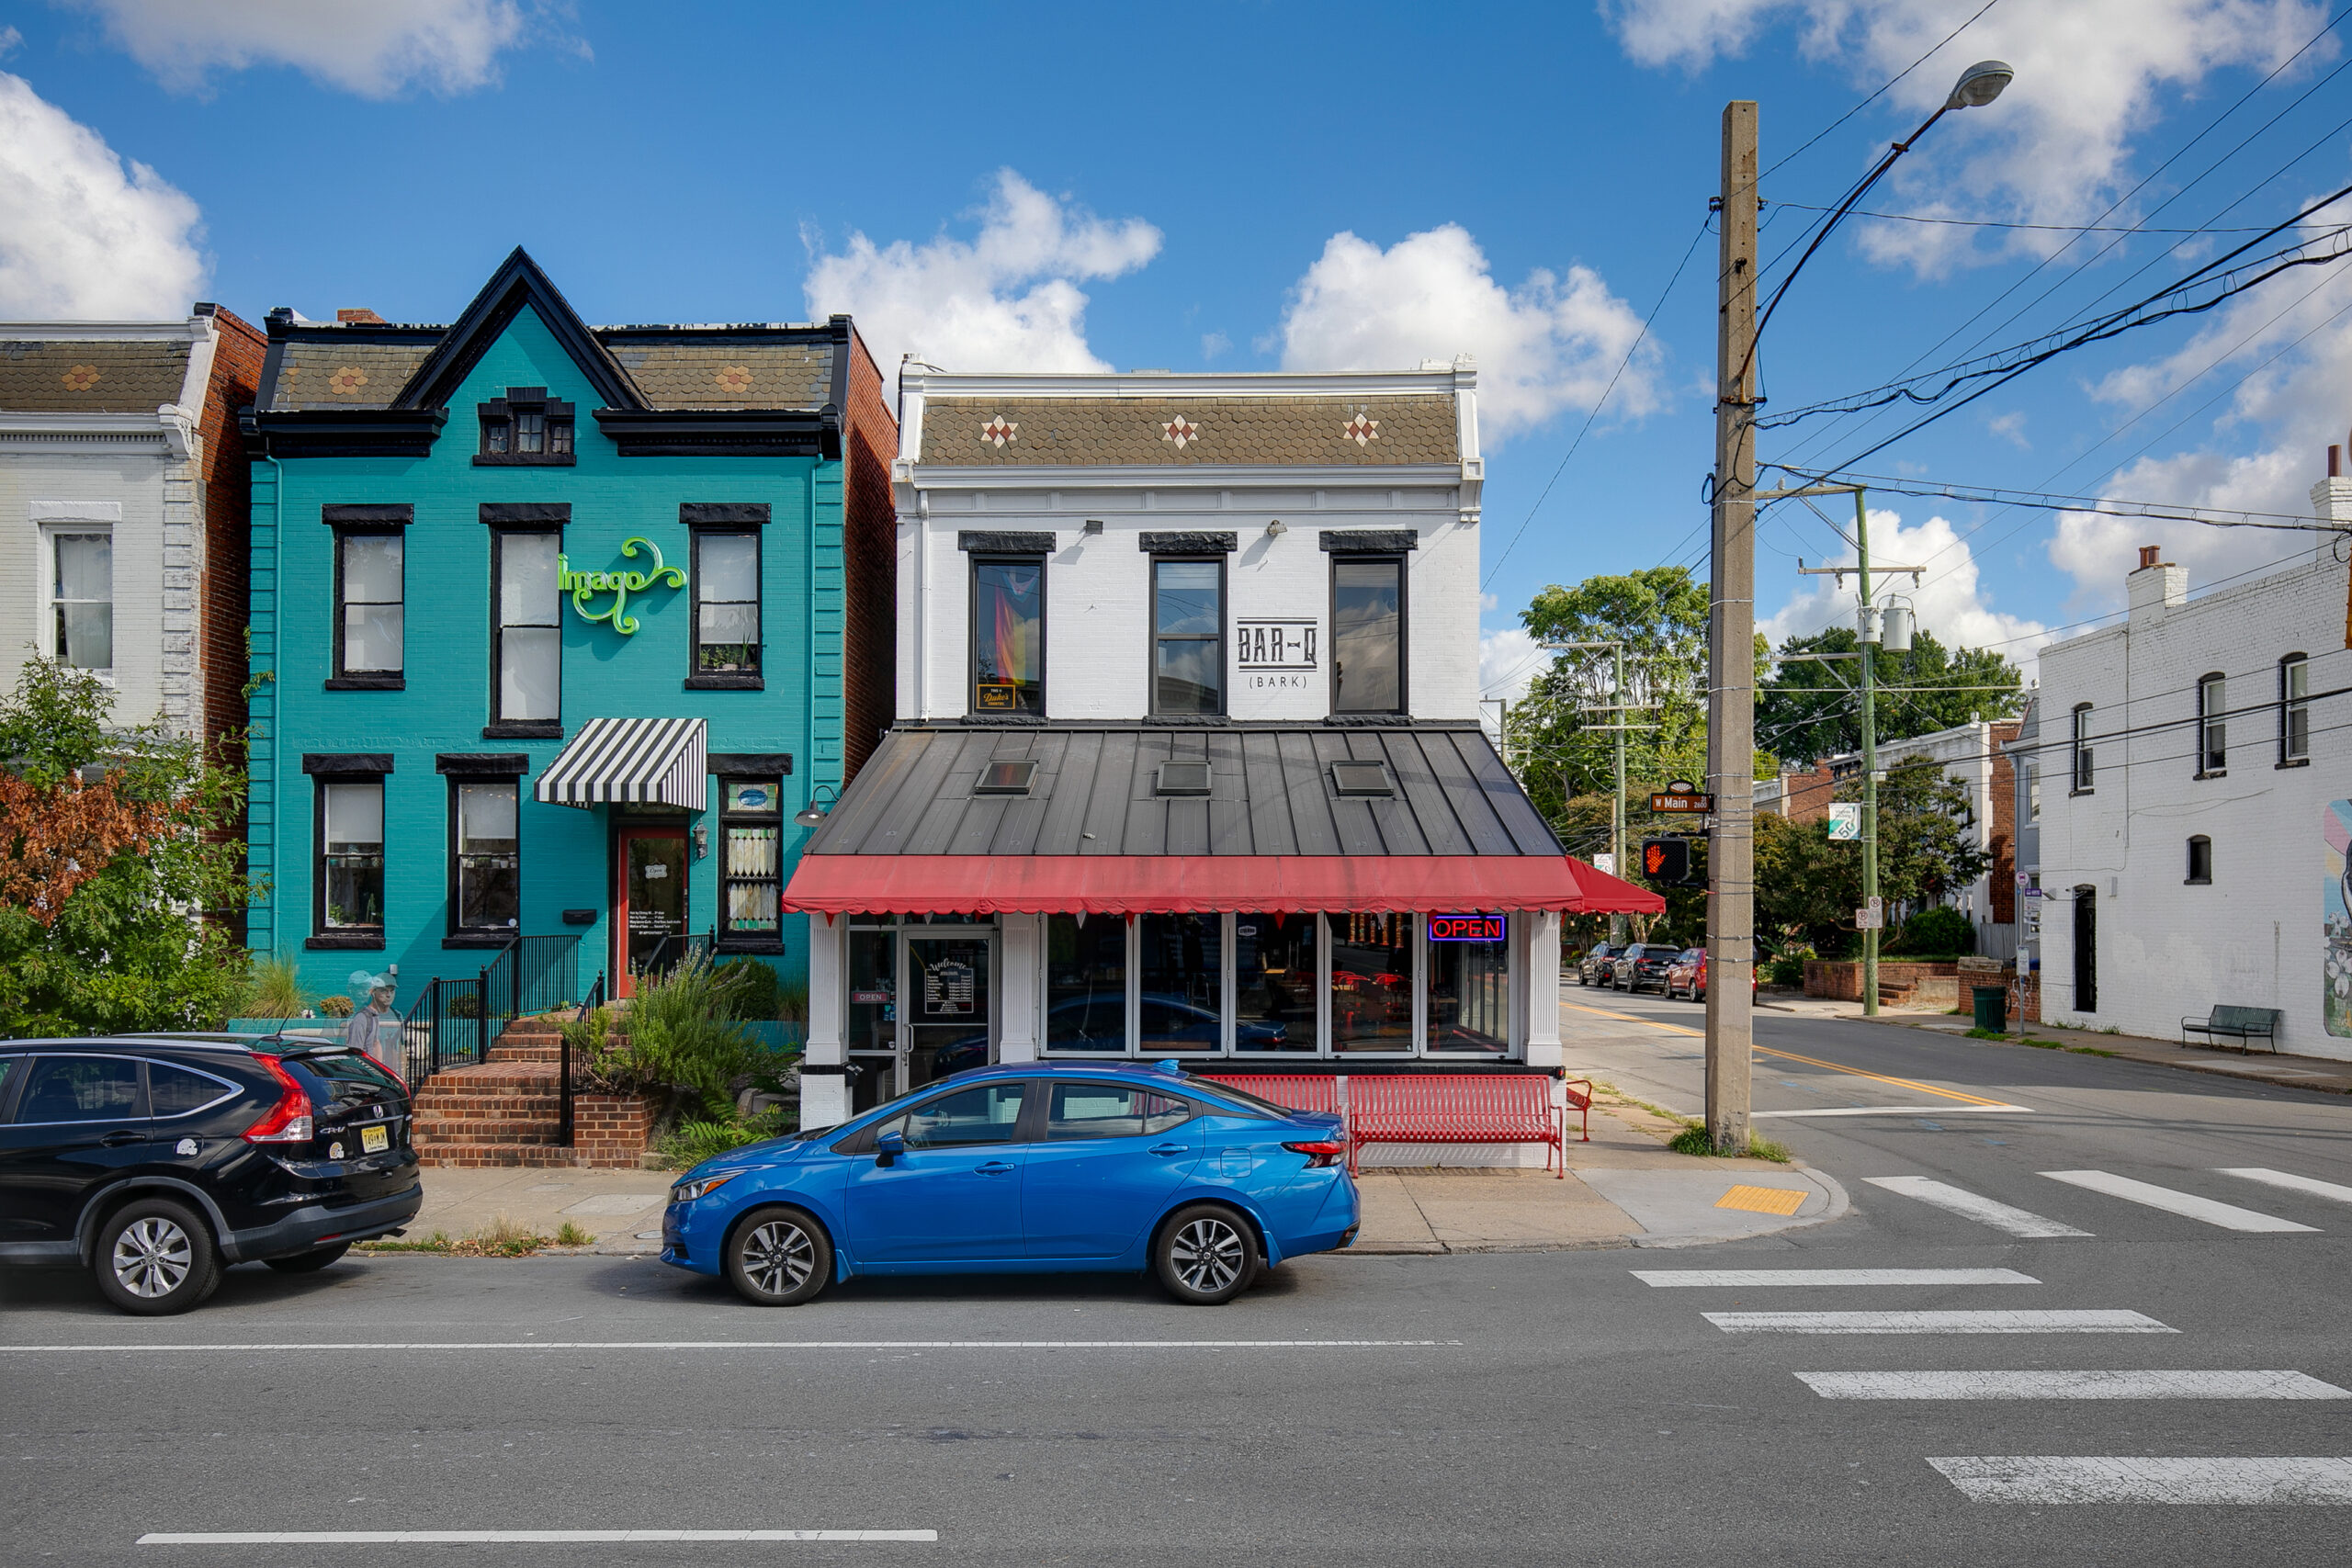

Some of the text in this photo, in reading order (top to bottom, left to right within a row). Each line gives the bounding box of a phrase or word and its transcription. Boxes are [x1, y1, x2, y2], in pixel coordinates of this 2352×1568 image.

[558, 537, 687, 636] imago
[1237, 627, 1317, 664] BAR-Q
[1250, 676, 1307, 689] (BARK)
[1655, 798, 1662, 807] W
[1664, 796, 1688, 808] Main
[1432, 919, 1500, 938] OPEN
[929, 957, 967, 972] Welcome
